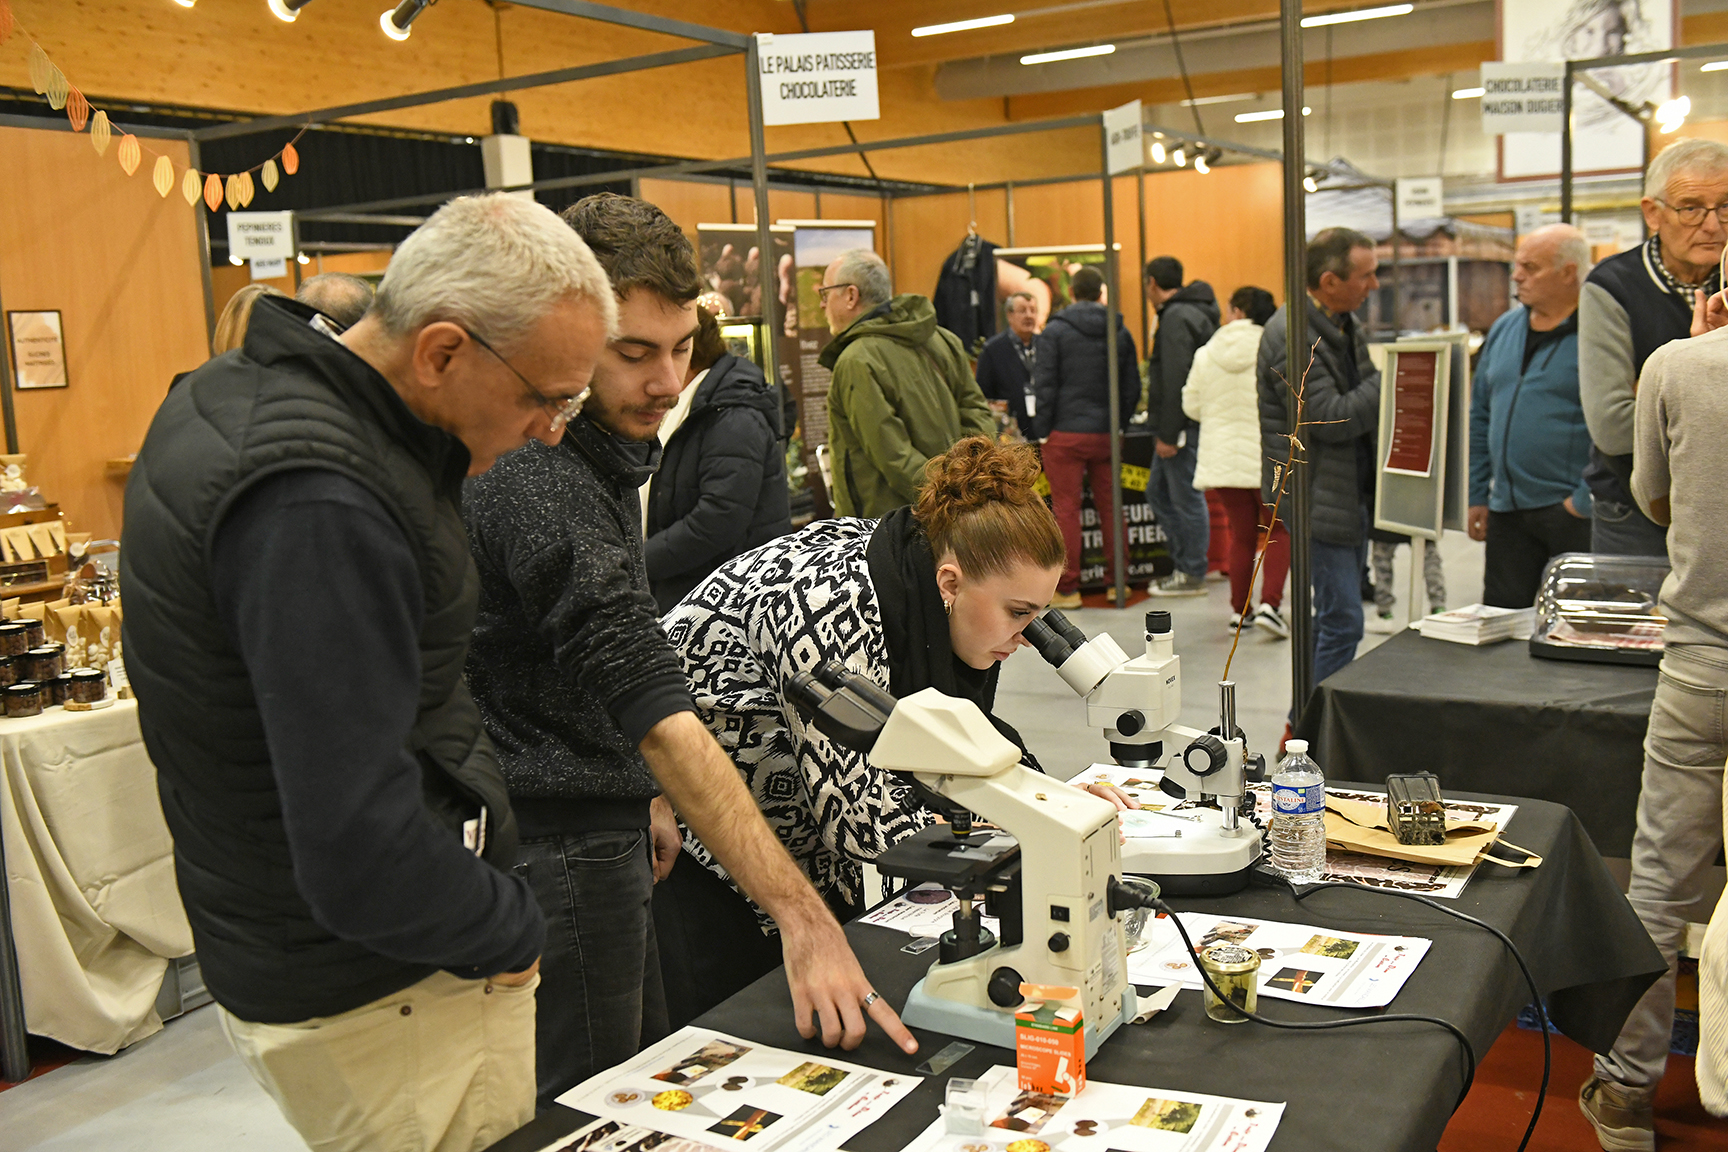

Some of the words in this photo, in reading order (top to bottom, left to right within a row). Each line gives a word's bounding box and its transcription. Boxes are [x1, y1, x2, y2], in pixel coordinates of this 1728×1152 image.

[760, 56, 774, 74] LE
[776, 54, 814, 73] PALAIS
[815, 51, 876, 72] PATISSERIE
[779, 79, 857, 100] CHOCOLATERIE
[1486, 76, 1559, 94] CHOCOLATERIE
[1483, 100, 1523, 114] MAISON
[1020, 1044, 1053, 1054] MICROSCOPE
[1053, 1049, 1072, 1058] SLIDES
